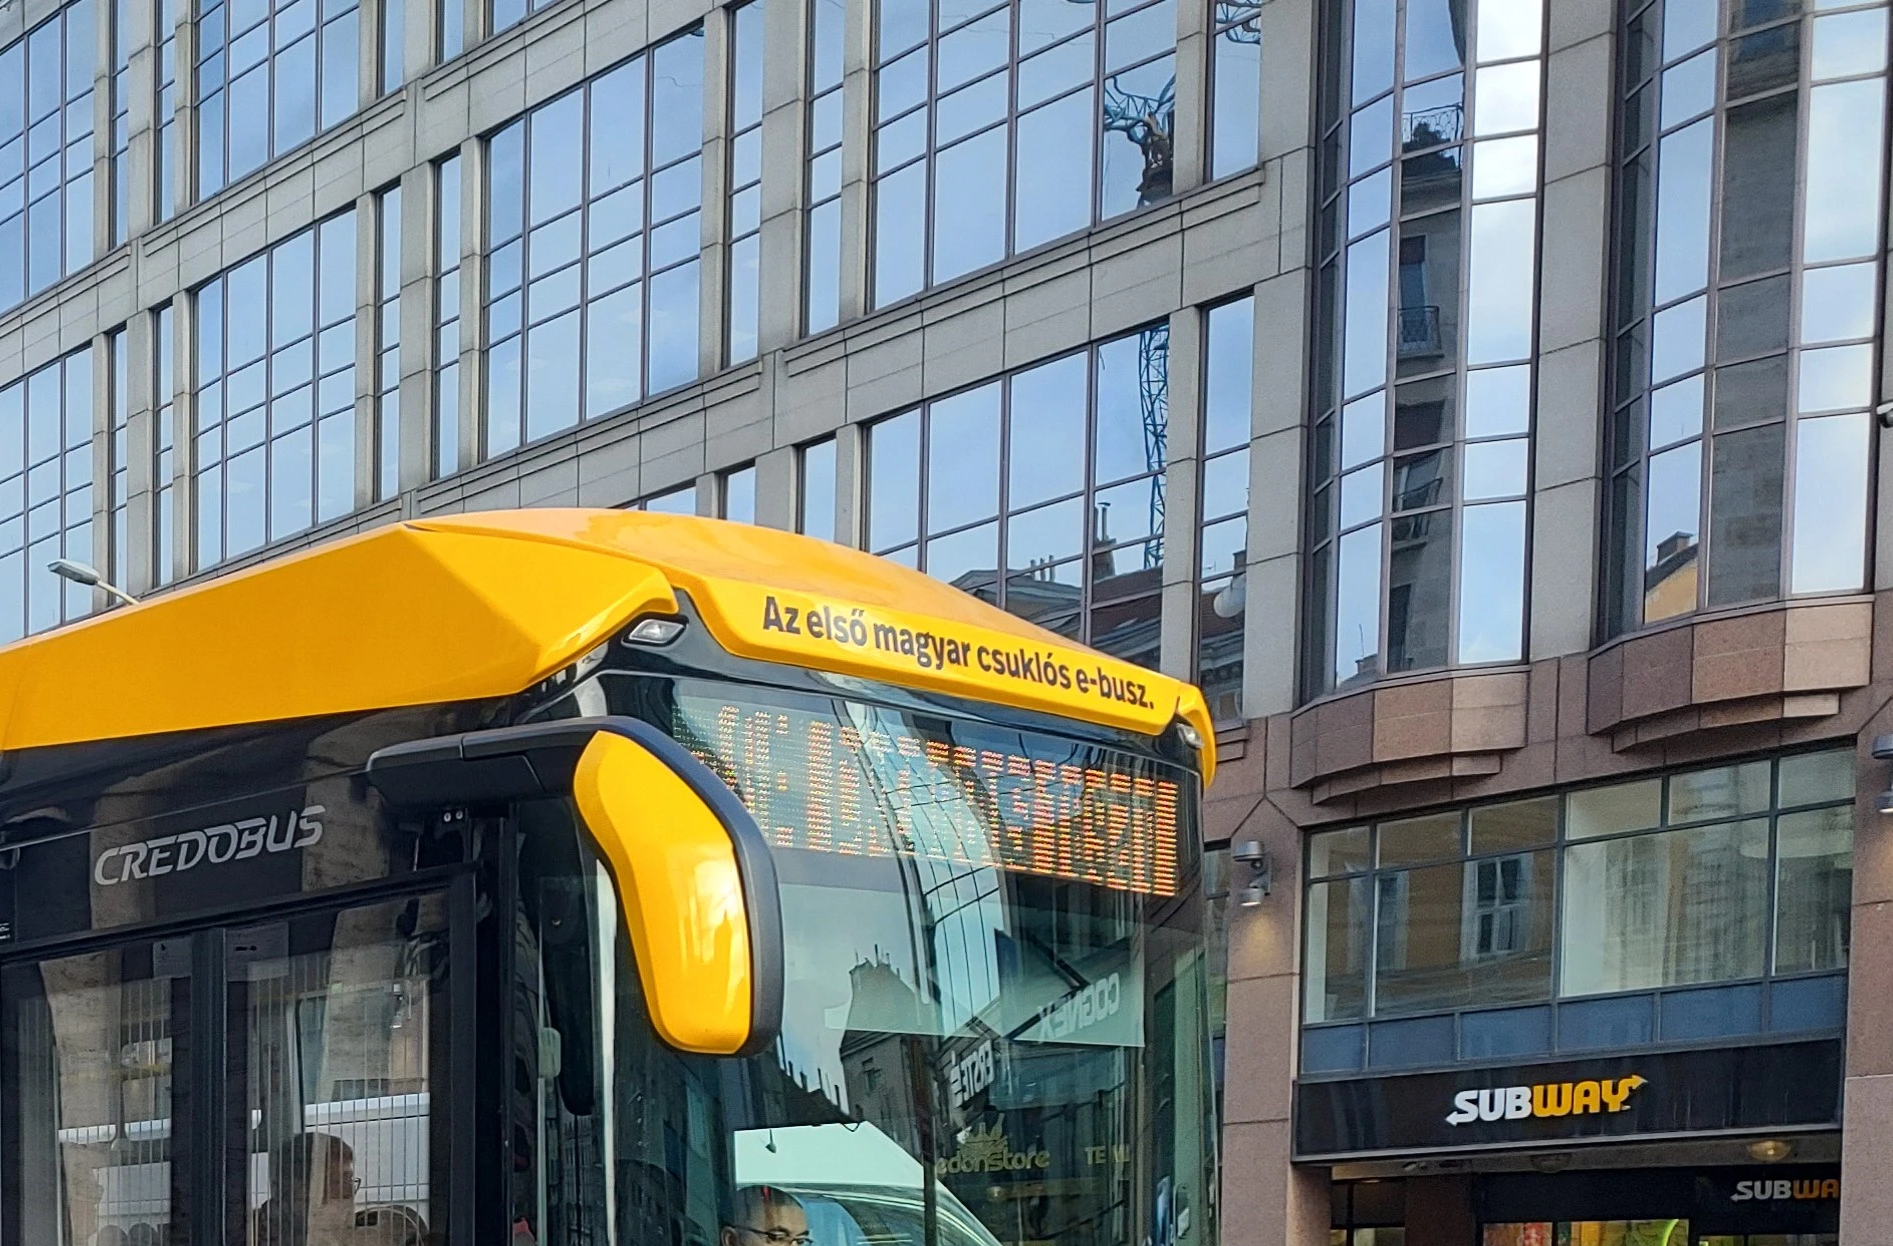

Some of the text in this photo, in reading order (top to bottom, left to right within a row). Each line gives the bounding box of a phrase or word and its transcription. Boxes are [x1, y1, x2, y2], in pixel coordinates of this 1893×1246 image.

[763, 596, 1155, 710] Az első magyar csuklós e-busz.
[94, 805, 326, 886] CREDOBUS
[1445, 1074, 1648, 1126] SUBWAY
